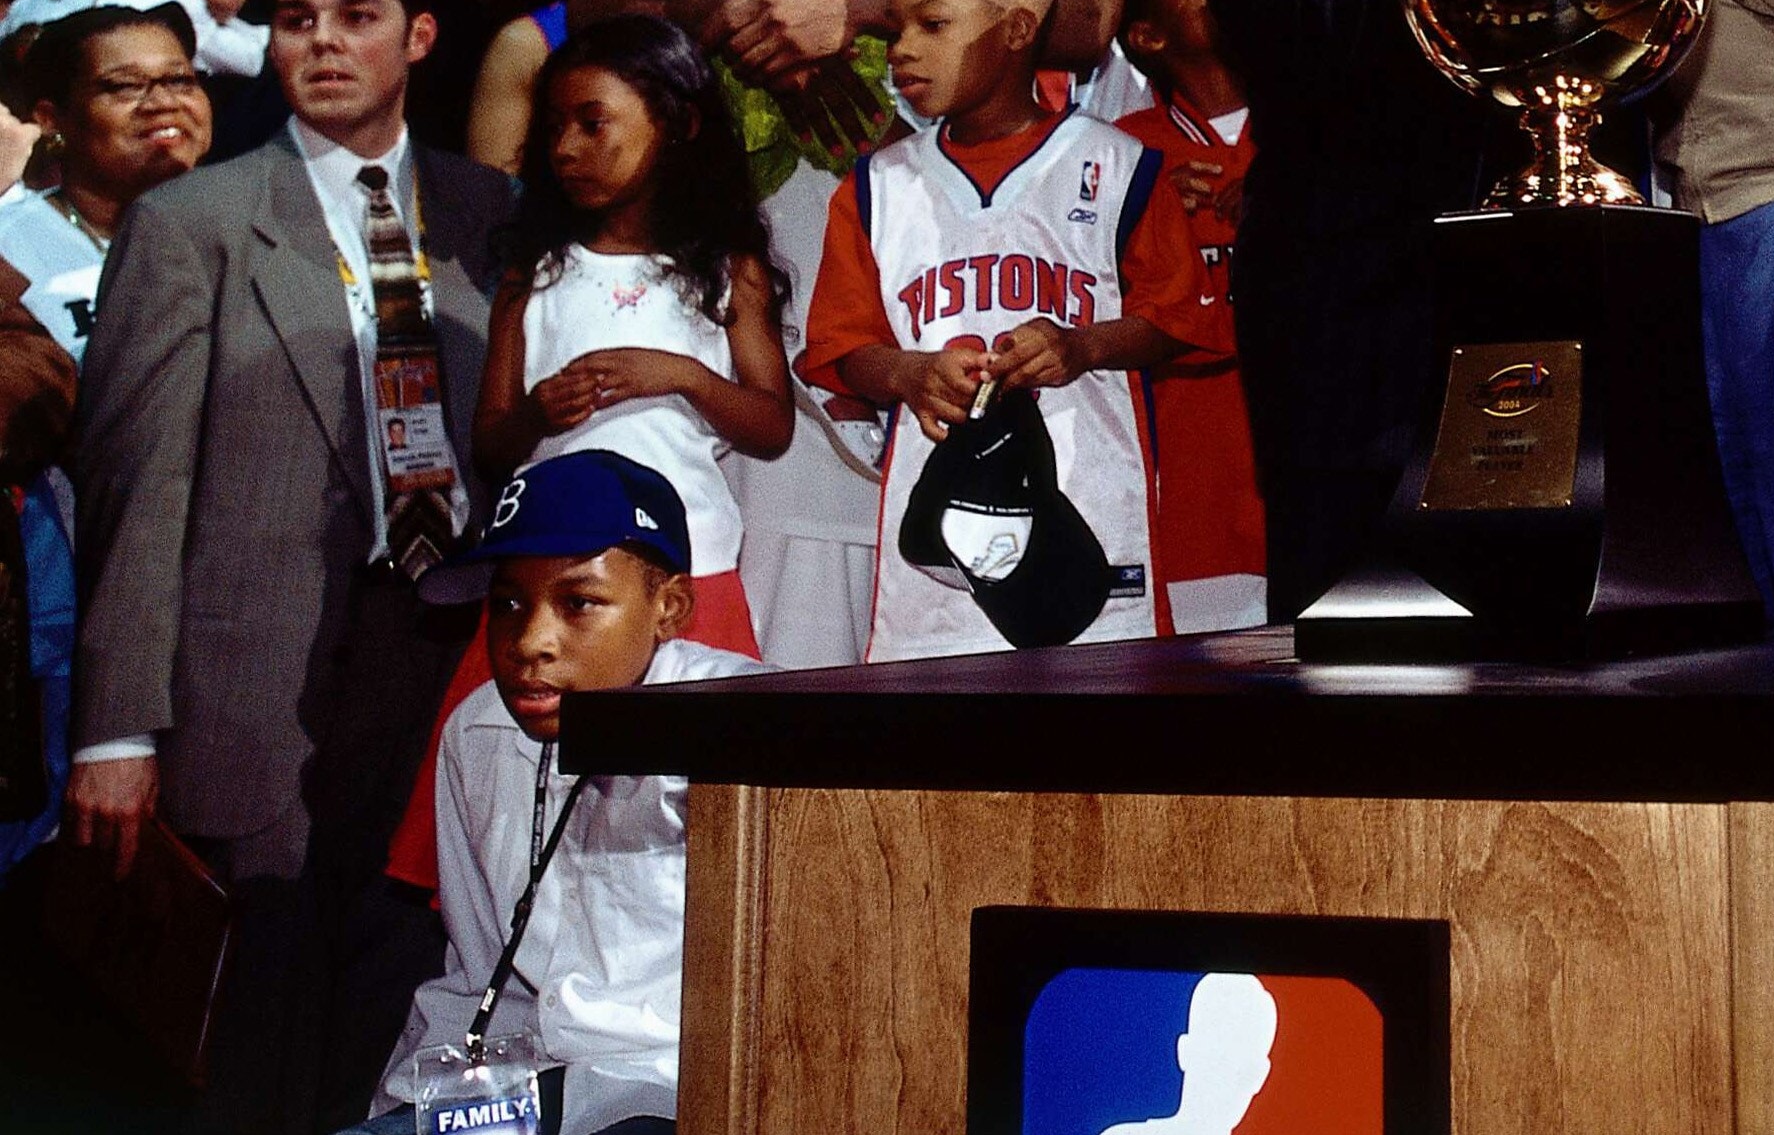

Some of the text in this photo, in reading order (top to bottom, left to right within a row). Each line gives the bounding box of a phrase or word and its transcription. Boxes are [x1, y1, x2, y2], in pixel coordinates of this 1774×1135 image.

[897, 252, 1098, 343] PISTONS
[1497, 399, 1521, 410] 2004
[492, 478, 527, 528] B
[437, 1096, 529, 1133] FAMILY
